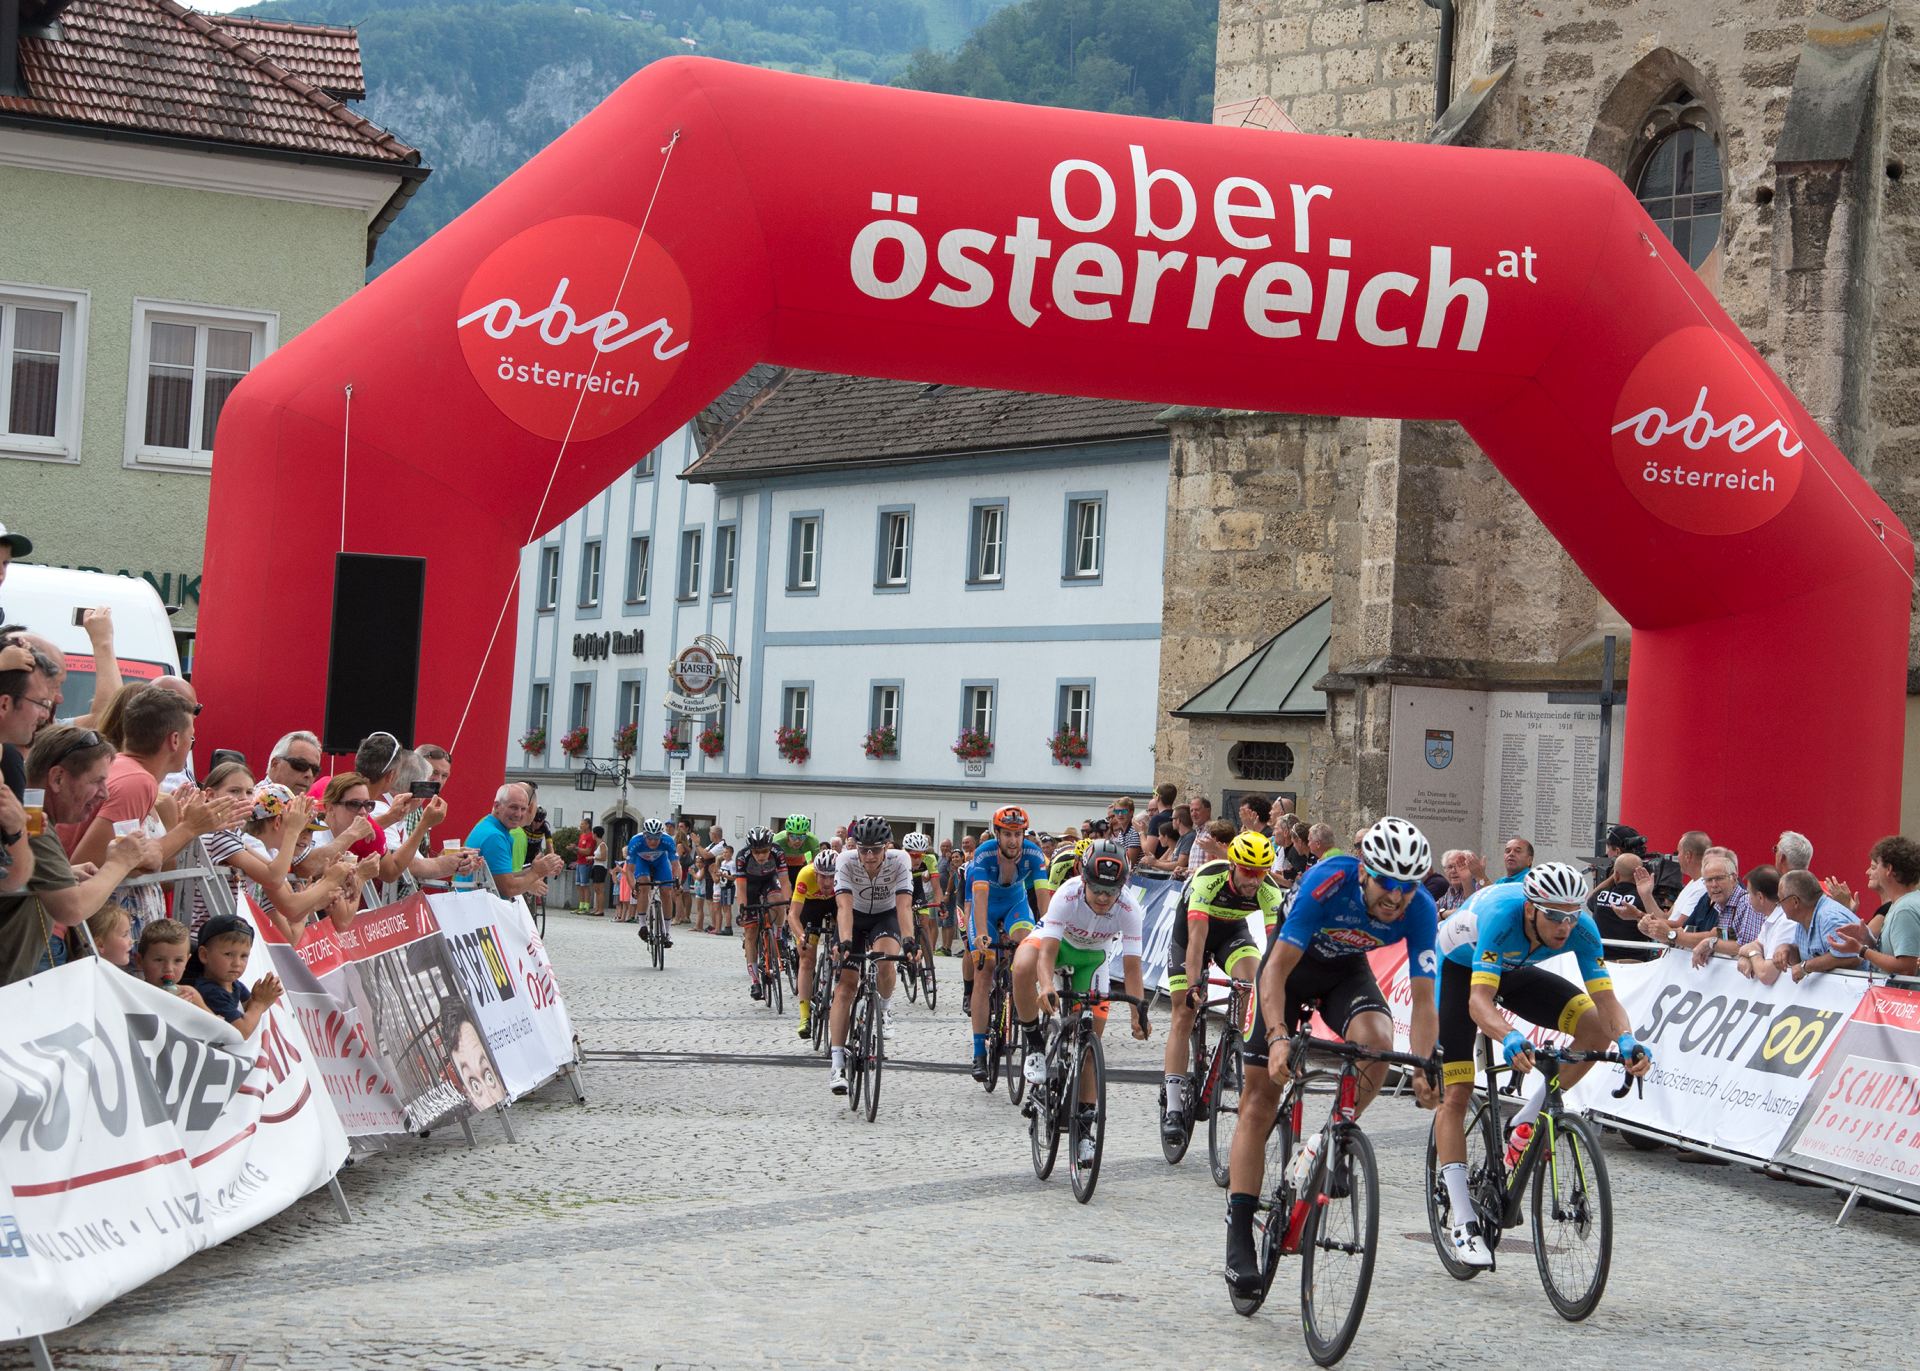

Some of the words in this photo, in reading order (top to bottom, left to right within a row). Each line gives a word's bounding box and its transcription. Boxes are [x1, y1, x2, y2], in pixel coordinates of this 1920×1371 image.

[1049, 144, 1334, 253] ober
[456, 277, 690, 361] ober
[497, 355, 641, 397] österreich
[1610, 386, 1804, 457] ober
[1642, 461, 1776, 492] österreich
[680, 662, 713, 675] KAISER
[1500, 709, 1512, 718] Die
[1515, 710, 1571, 721] Marktgemeinde
[1573, 710, 1585, 720] für
[1527, 722, 1542, 730] 1914
[1558, 722, 1573, 730] 1918
[364, 912, 410, 943] GARAGENTORE
[1634, 983, 1776, 1062] SPORT
[1720, 1079, 1761, 1111] Upper
[1760, 1089, 1800, 1117] Austria
